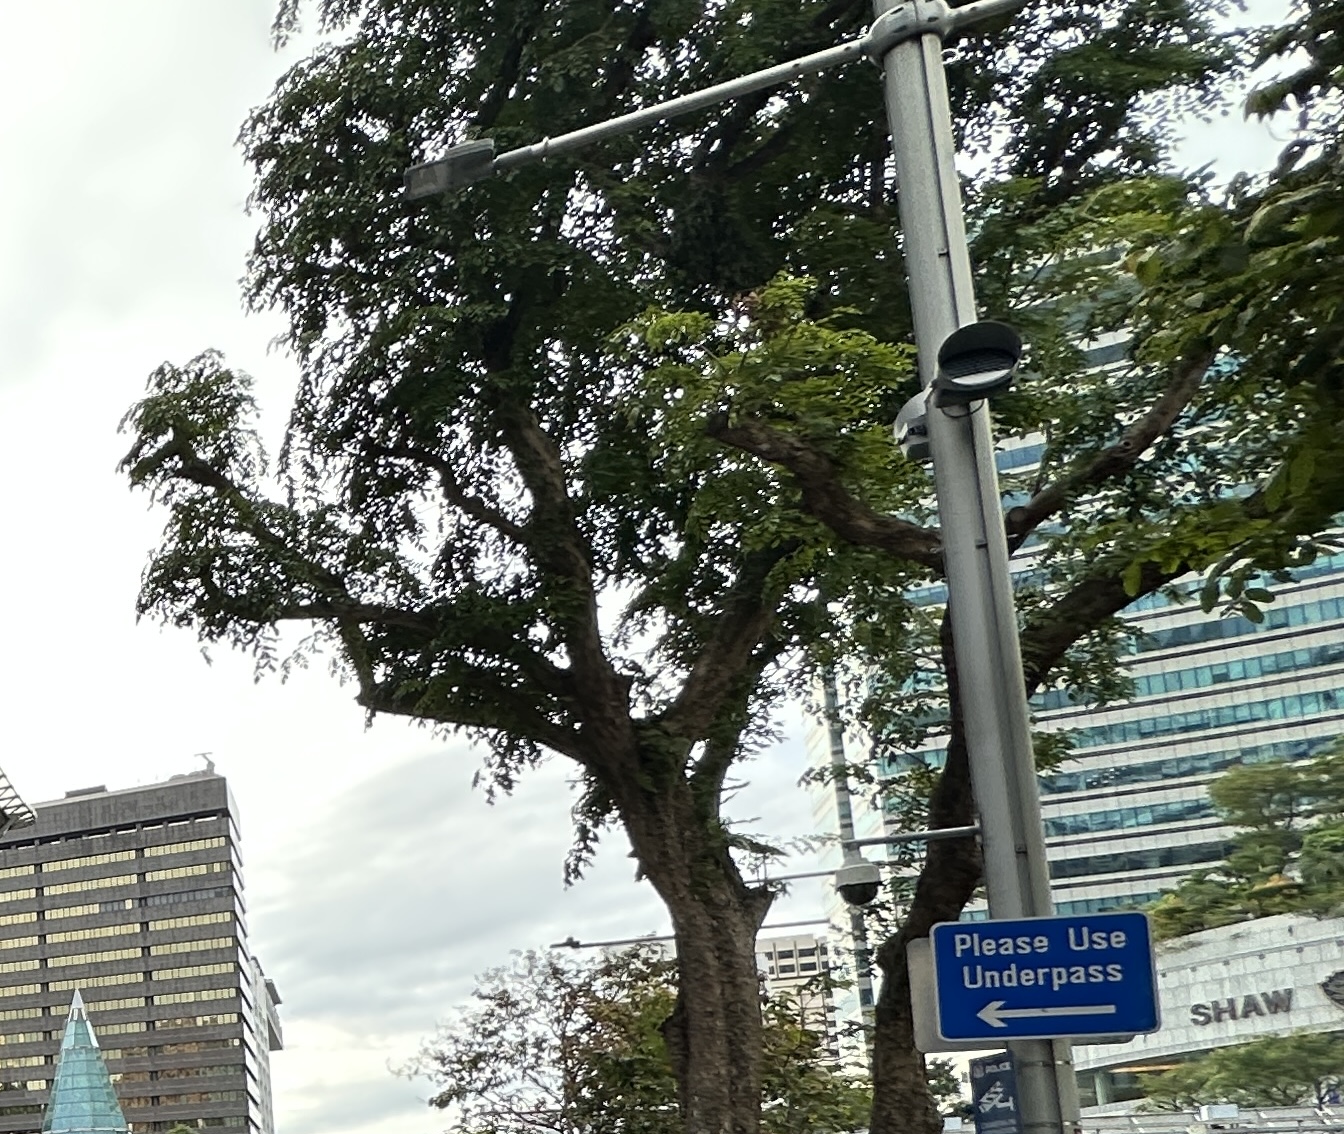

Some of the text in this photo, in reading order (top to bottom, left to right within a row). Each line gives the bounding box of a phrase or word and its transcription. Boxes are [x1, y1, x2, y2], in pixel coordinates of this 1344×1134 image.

[955, 927, 1127, 957] Please Use
[963, 963, 1123, 991] Underpass
[1190, 987, 1294, 1026] SHAW
